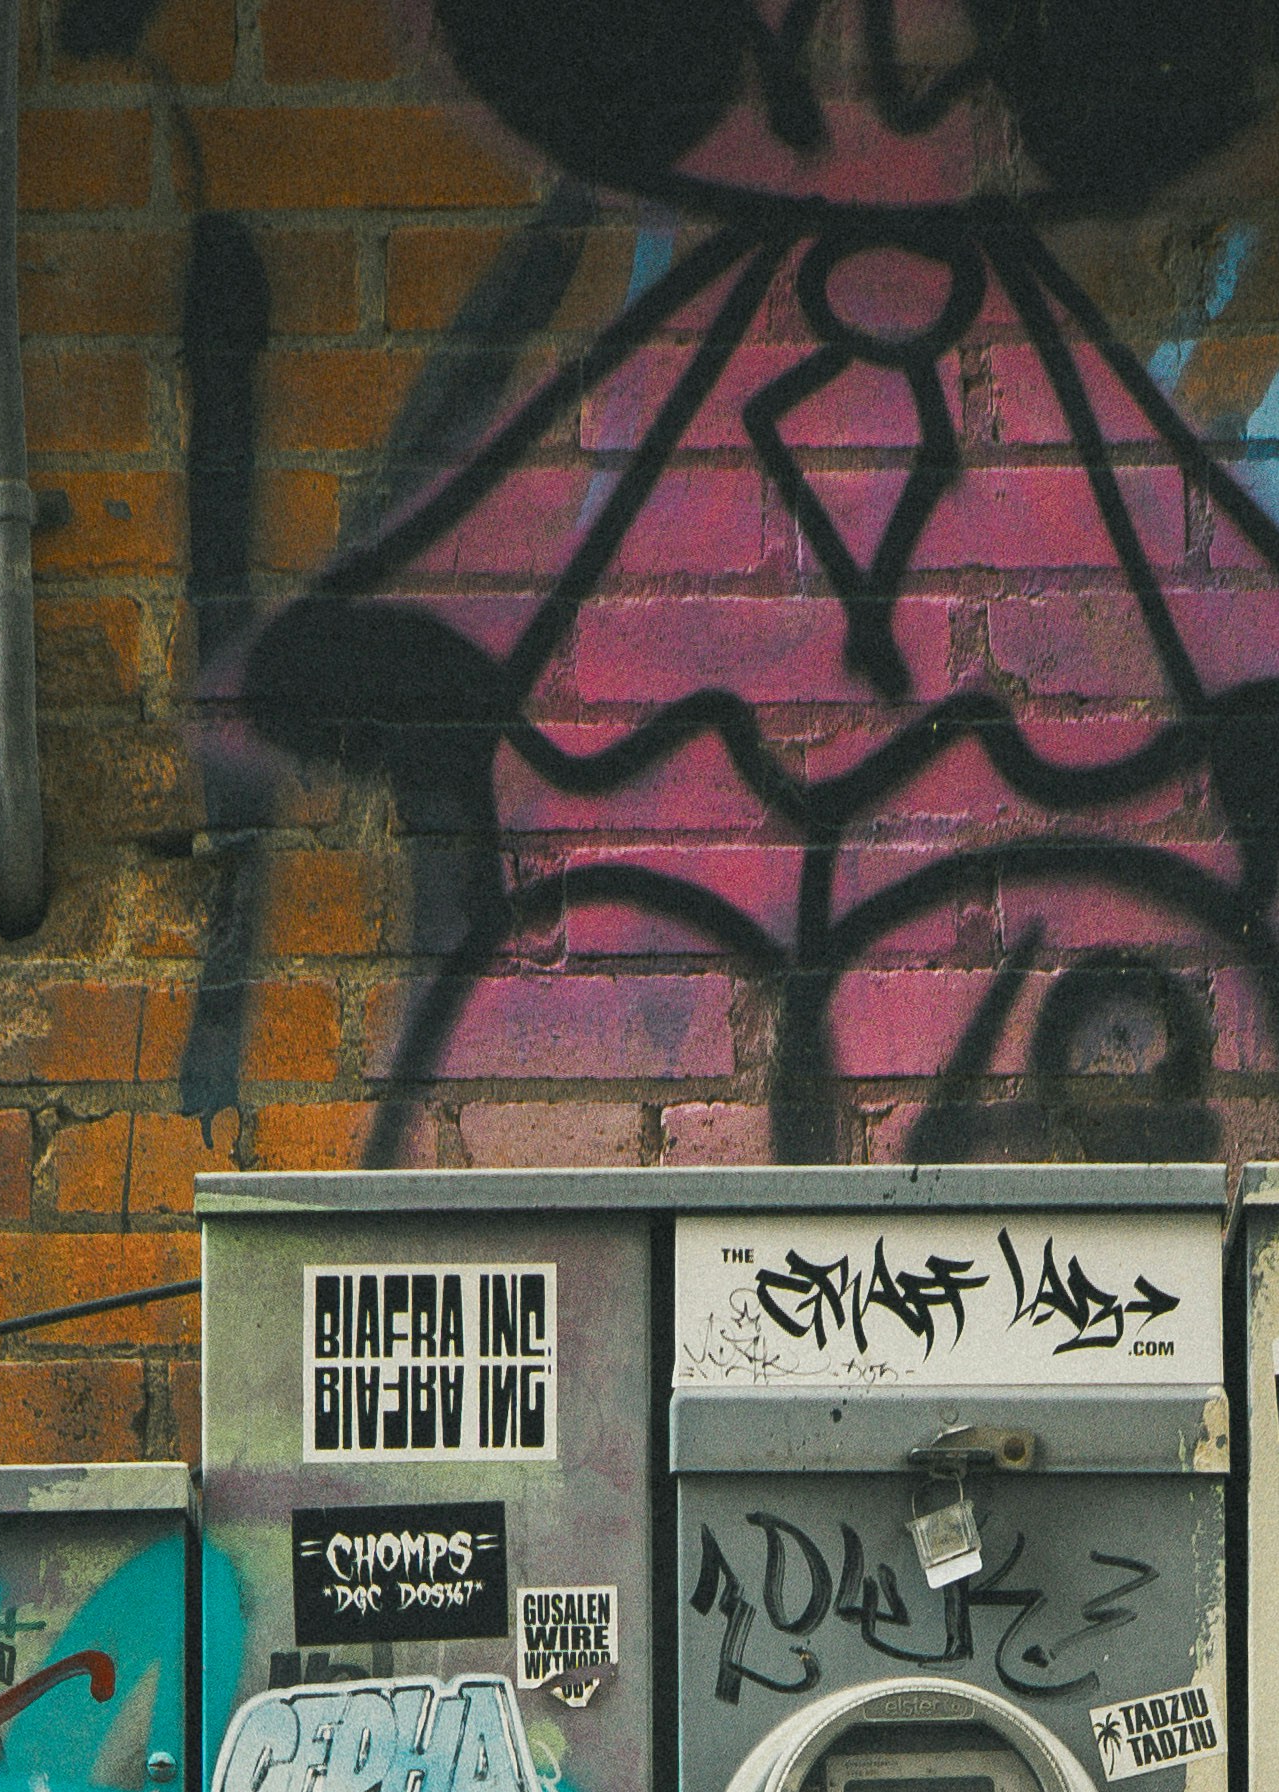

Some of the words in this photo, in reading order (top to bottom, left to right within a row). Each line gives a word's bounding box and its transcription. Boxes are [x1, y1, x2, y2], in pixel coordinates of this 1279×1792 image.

[315, 1274, 464, 1358] BIAFRA
[721, 1247, 754, 1265] THE
[1128, 1340, 1175, 1357] .COM
[523, 1592, 611, 1626] GUSALEN
[524, 1625, 610, 1651] WIRE
[1120, 1687, 1210, 1735] TADZIU
[1126, 1718, 1218, 1768] TADZIU
